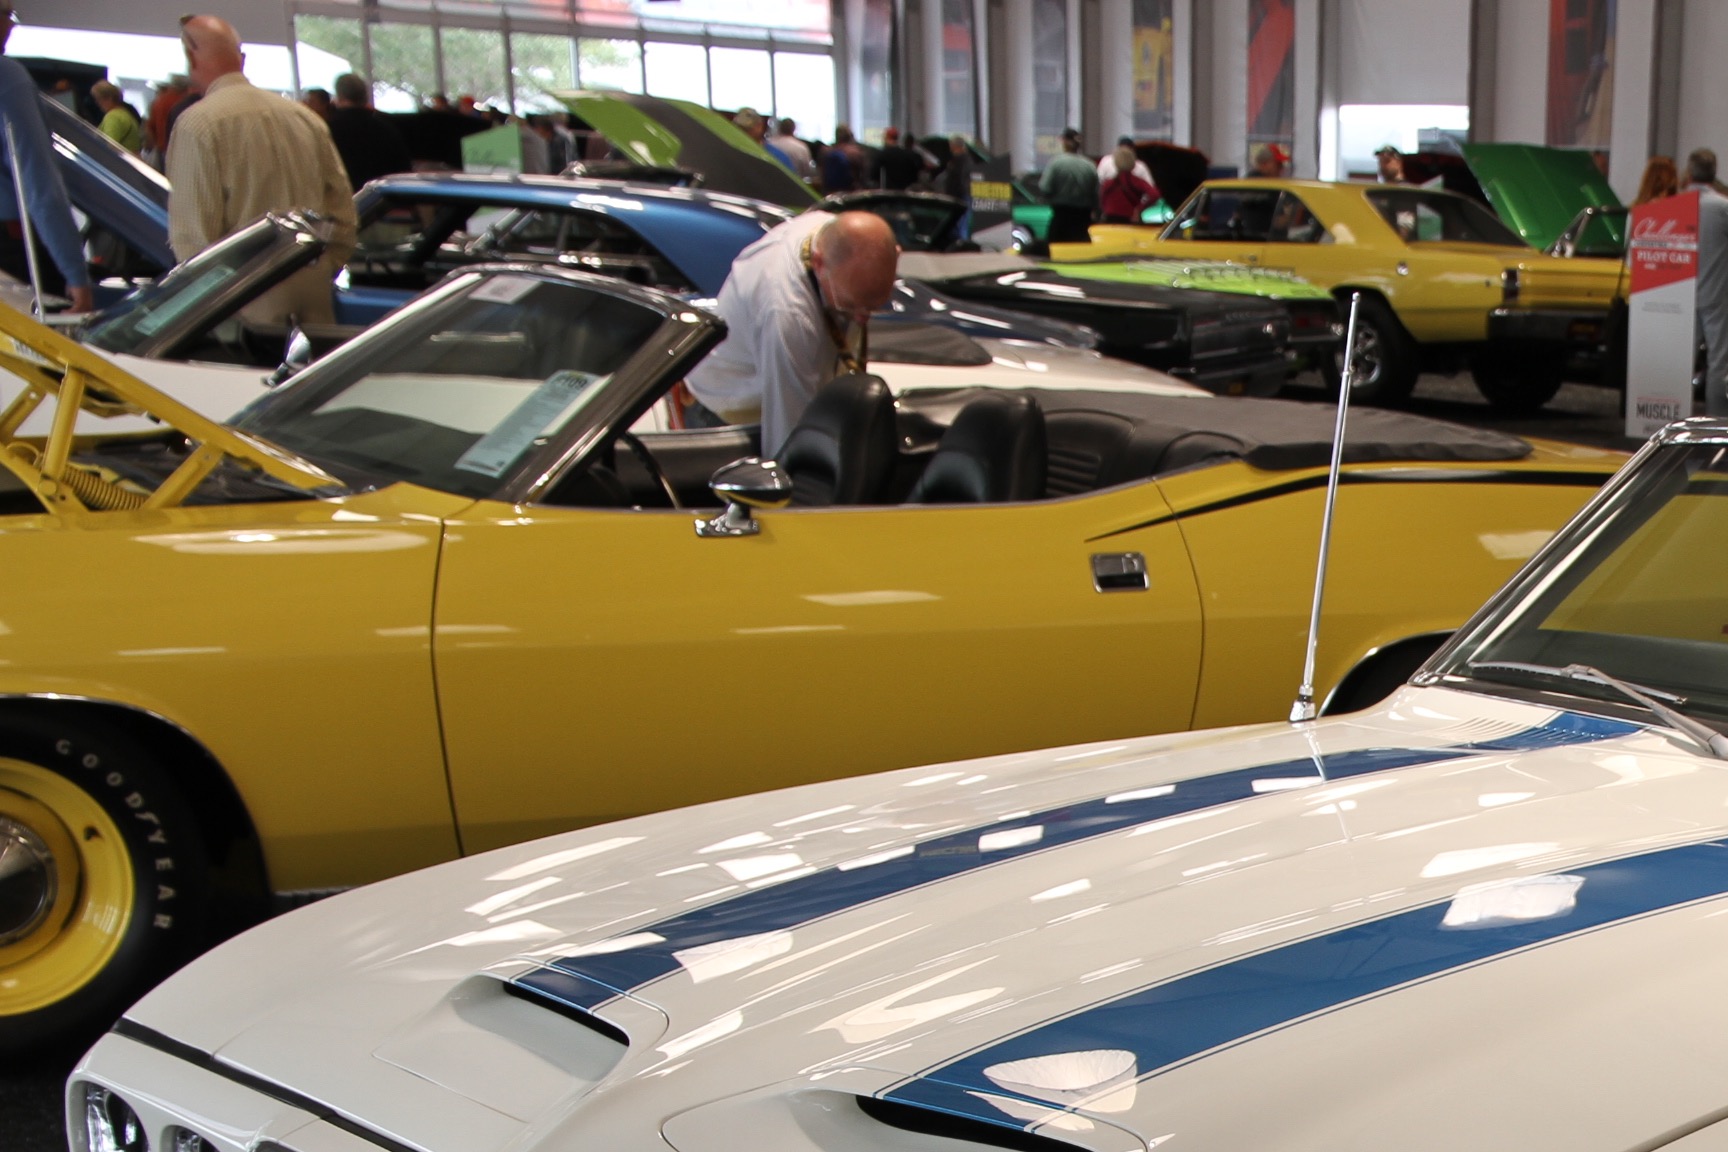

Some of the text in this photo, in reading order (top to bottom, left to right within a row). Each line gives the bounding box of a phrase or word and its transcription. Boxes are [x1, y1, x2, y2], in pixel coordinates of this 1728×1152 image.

[1637, 250, 1692, 264] PILOT CAR
[1636, 403, 1680, 419] MUSCLE
[56, 739, 176, 929] GOODYEAR
